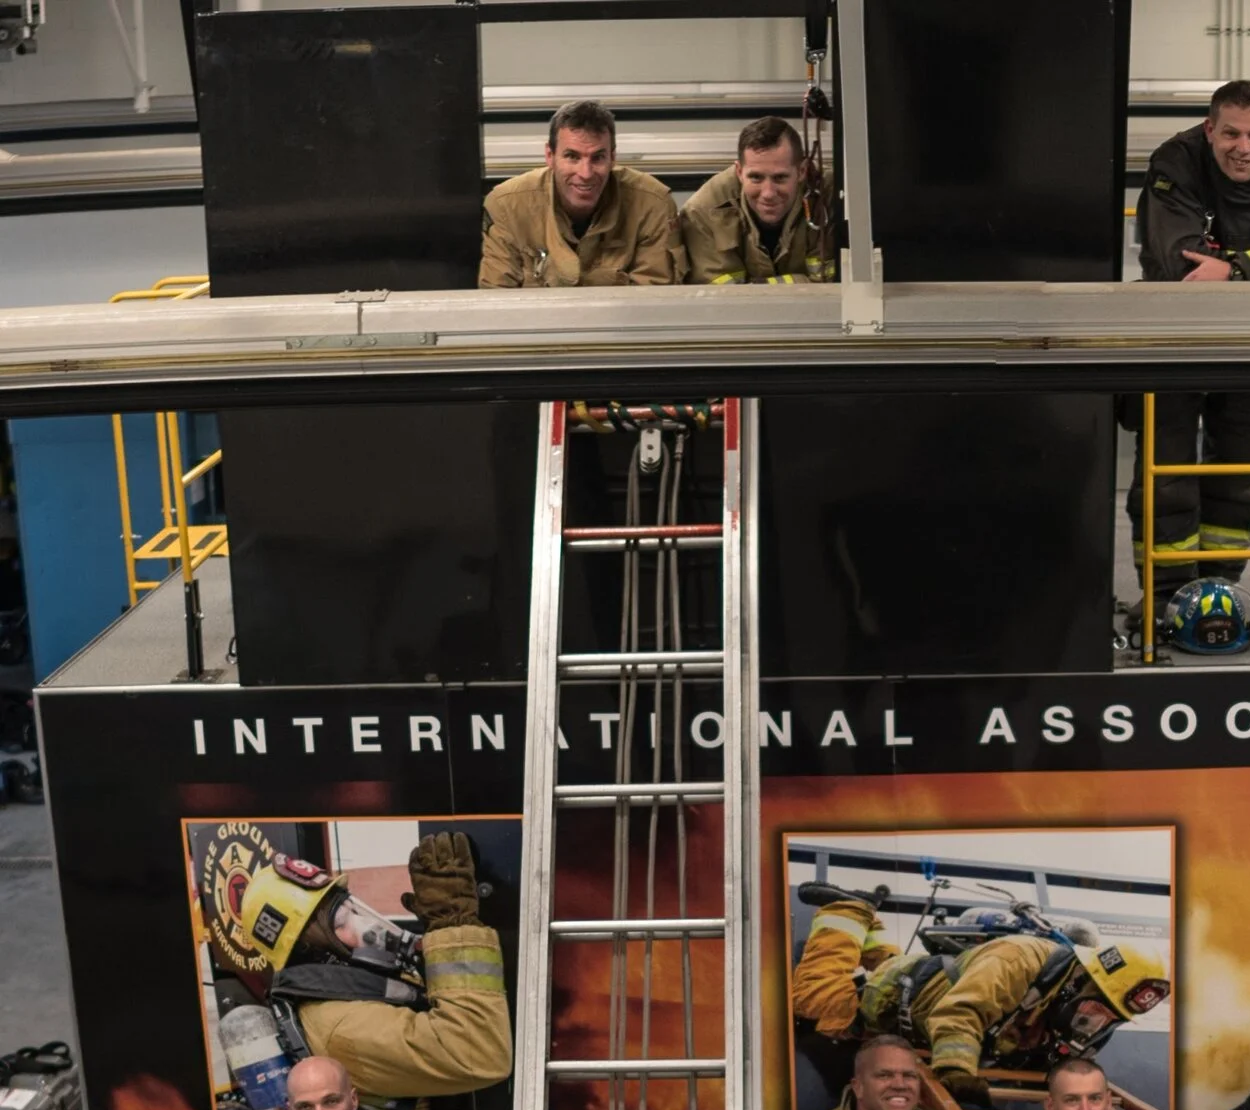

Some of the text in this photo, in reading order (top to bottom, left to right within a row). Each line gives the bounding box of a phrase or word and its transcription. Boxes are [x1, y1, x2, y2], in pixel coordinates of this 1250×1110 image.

[193, 708, 914, 755] INTERNTIONAL
[204, 822, 274, 894] FIRE GROUN
